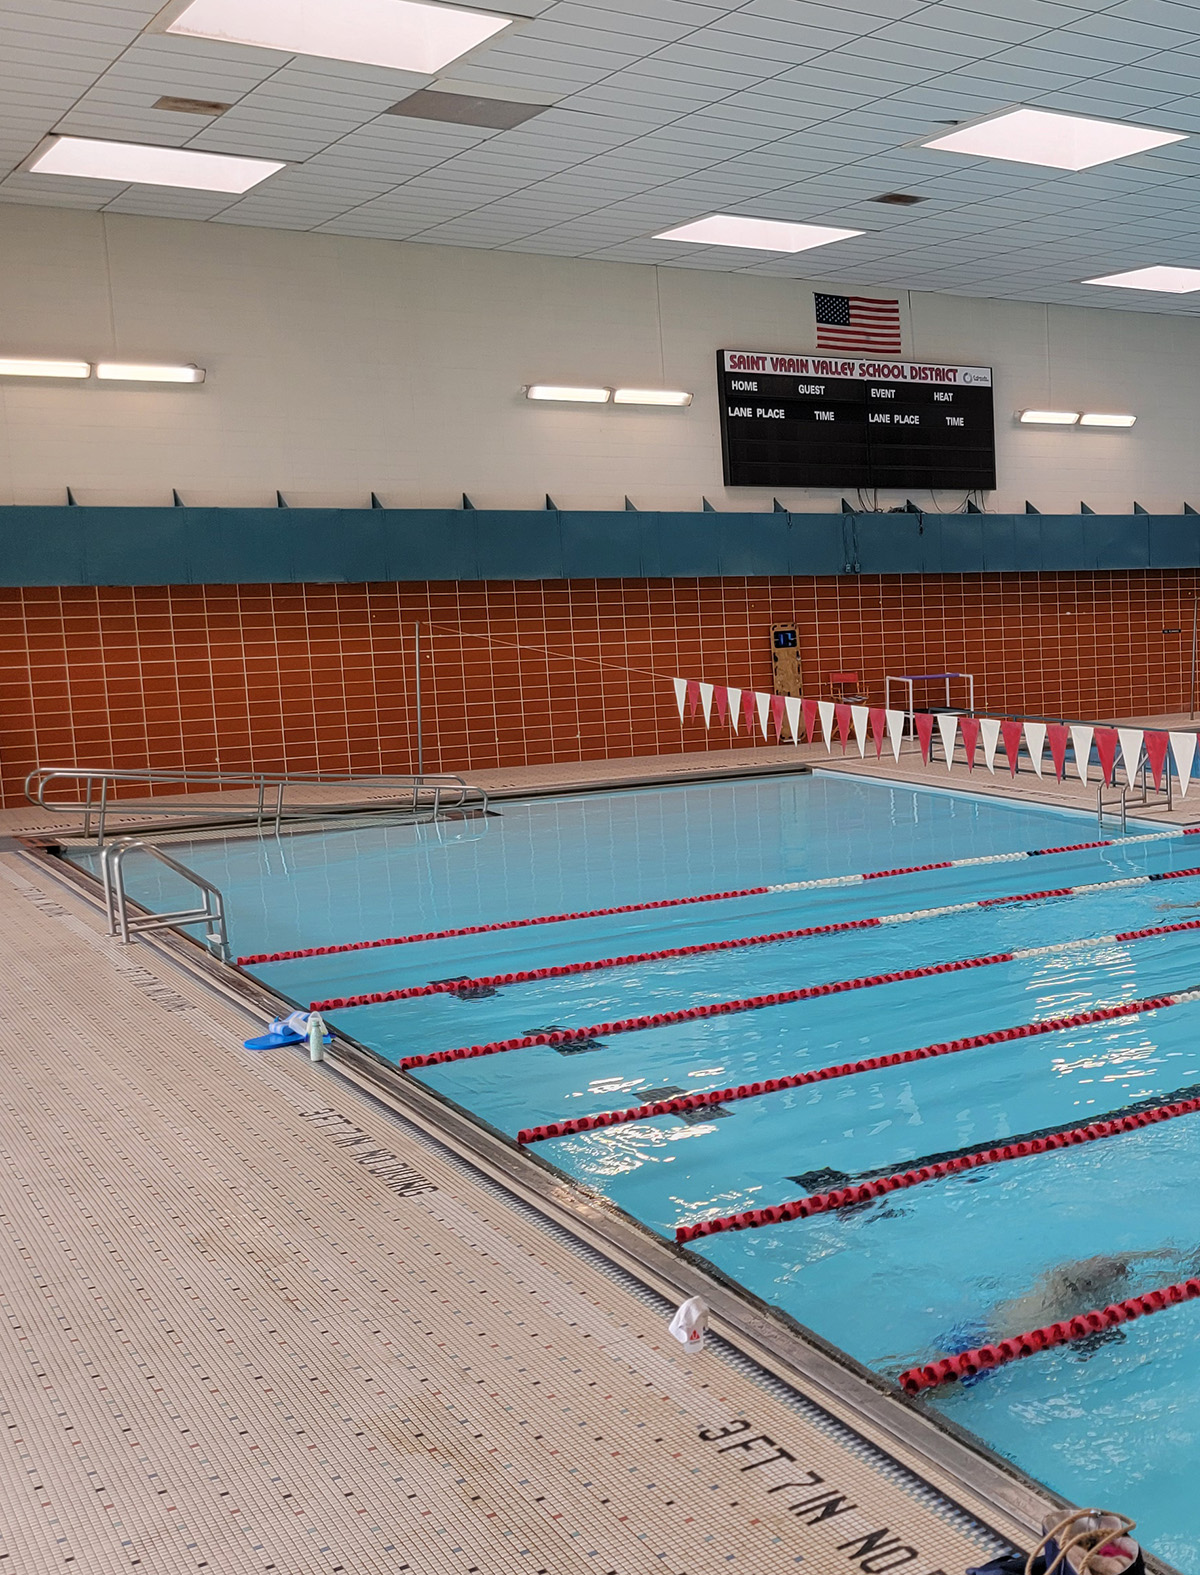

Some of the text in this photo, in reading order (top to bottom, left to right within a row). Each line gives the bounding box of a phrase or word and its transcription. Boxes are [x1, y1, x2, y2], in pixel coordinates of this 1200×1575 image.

[729, 354, 768, 371] SAINT
[770, 356, 809, 374] VRAIN
[813, 360, 855, 377] VALLEY
[859, 362, 907, 379] SCHOOL
[910, 366, 959, 382] DISTRICT
[731, 380, 758, 392] HOME
[798, 384, 825, 395] GUEST
[871, 388, 896, 399] EVENT
[933, 392, 954, 402] HEAT
[728, 406, 785, 419] LANE PLACE
[814, 411, 835, 421] TIME
[868, 413, 920, 425] LANE PLACE
[945, 416, 965, 427] TIME
[350, 1148, 398, 1165] NO
[368, 1162, 440, 1198] DIVING
[836, 1527, 919, 1575] NO
